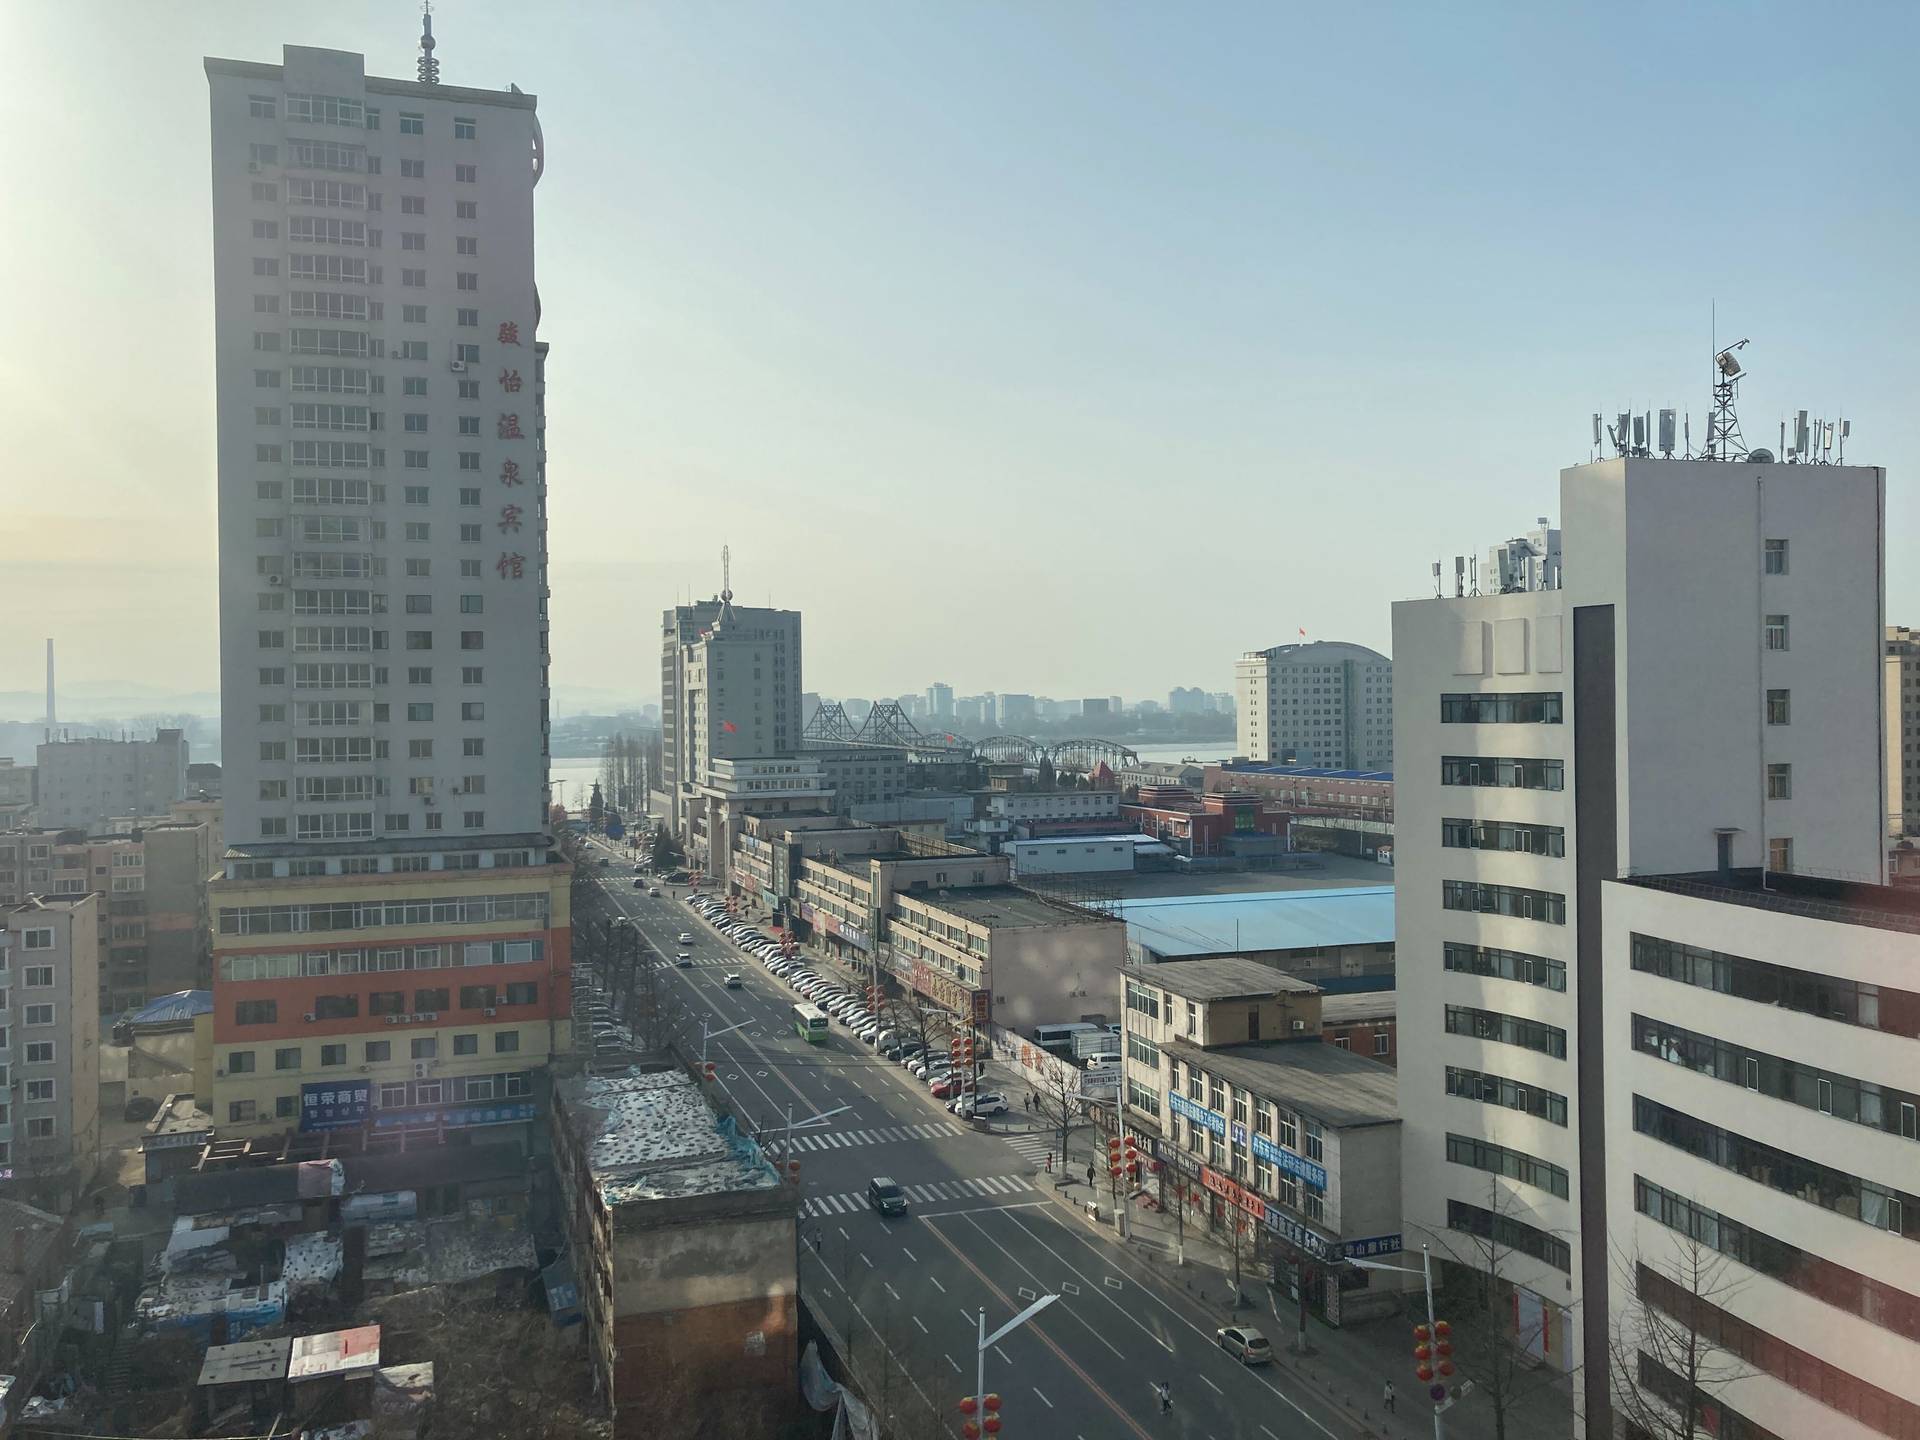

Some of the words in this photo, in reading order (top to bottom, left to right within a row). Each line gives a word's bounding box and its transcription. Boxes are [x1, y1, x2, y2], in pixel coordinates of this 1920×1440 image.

[496, 321, 526, 580] 骏怡温泉宾馆
[304, 1089, 368, 1106] 恒荣商贸
